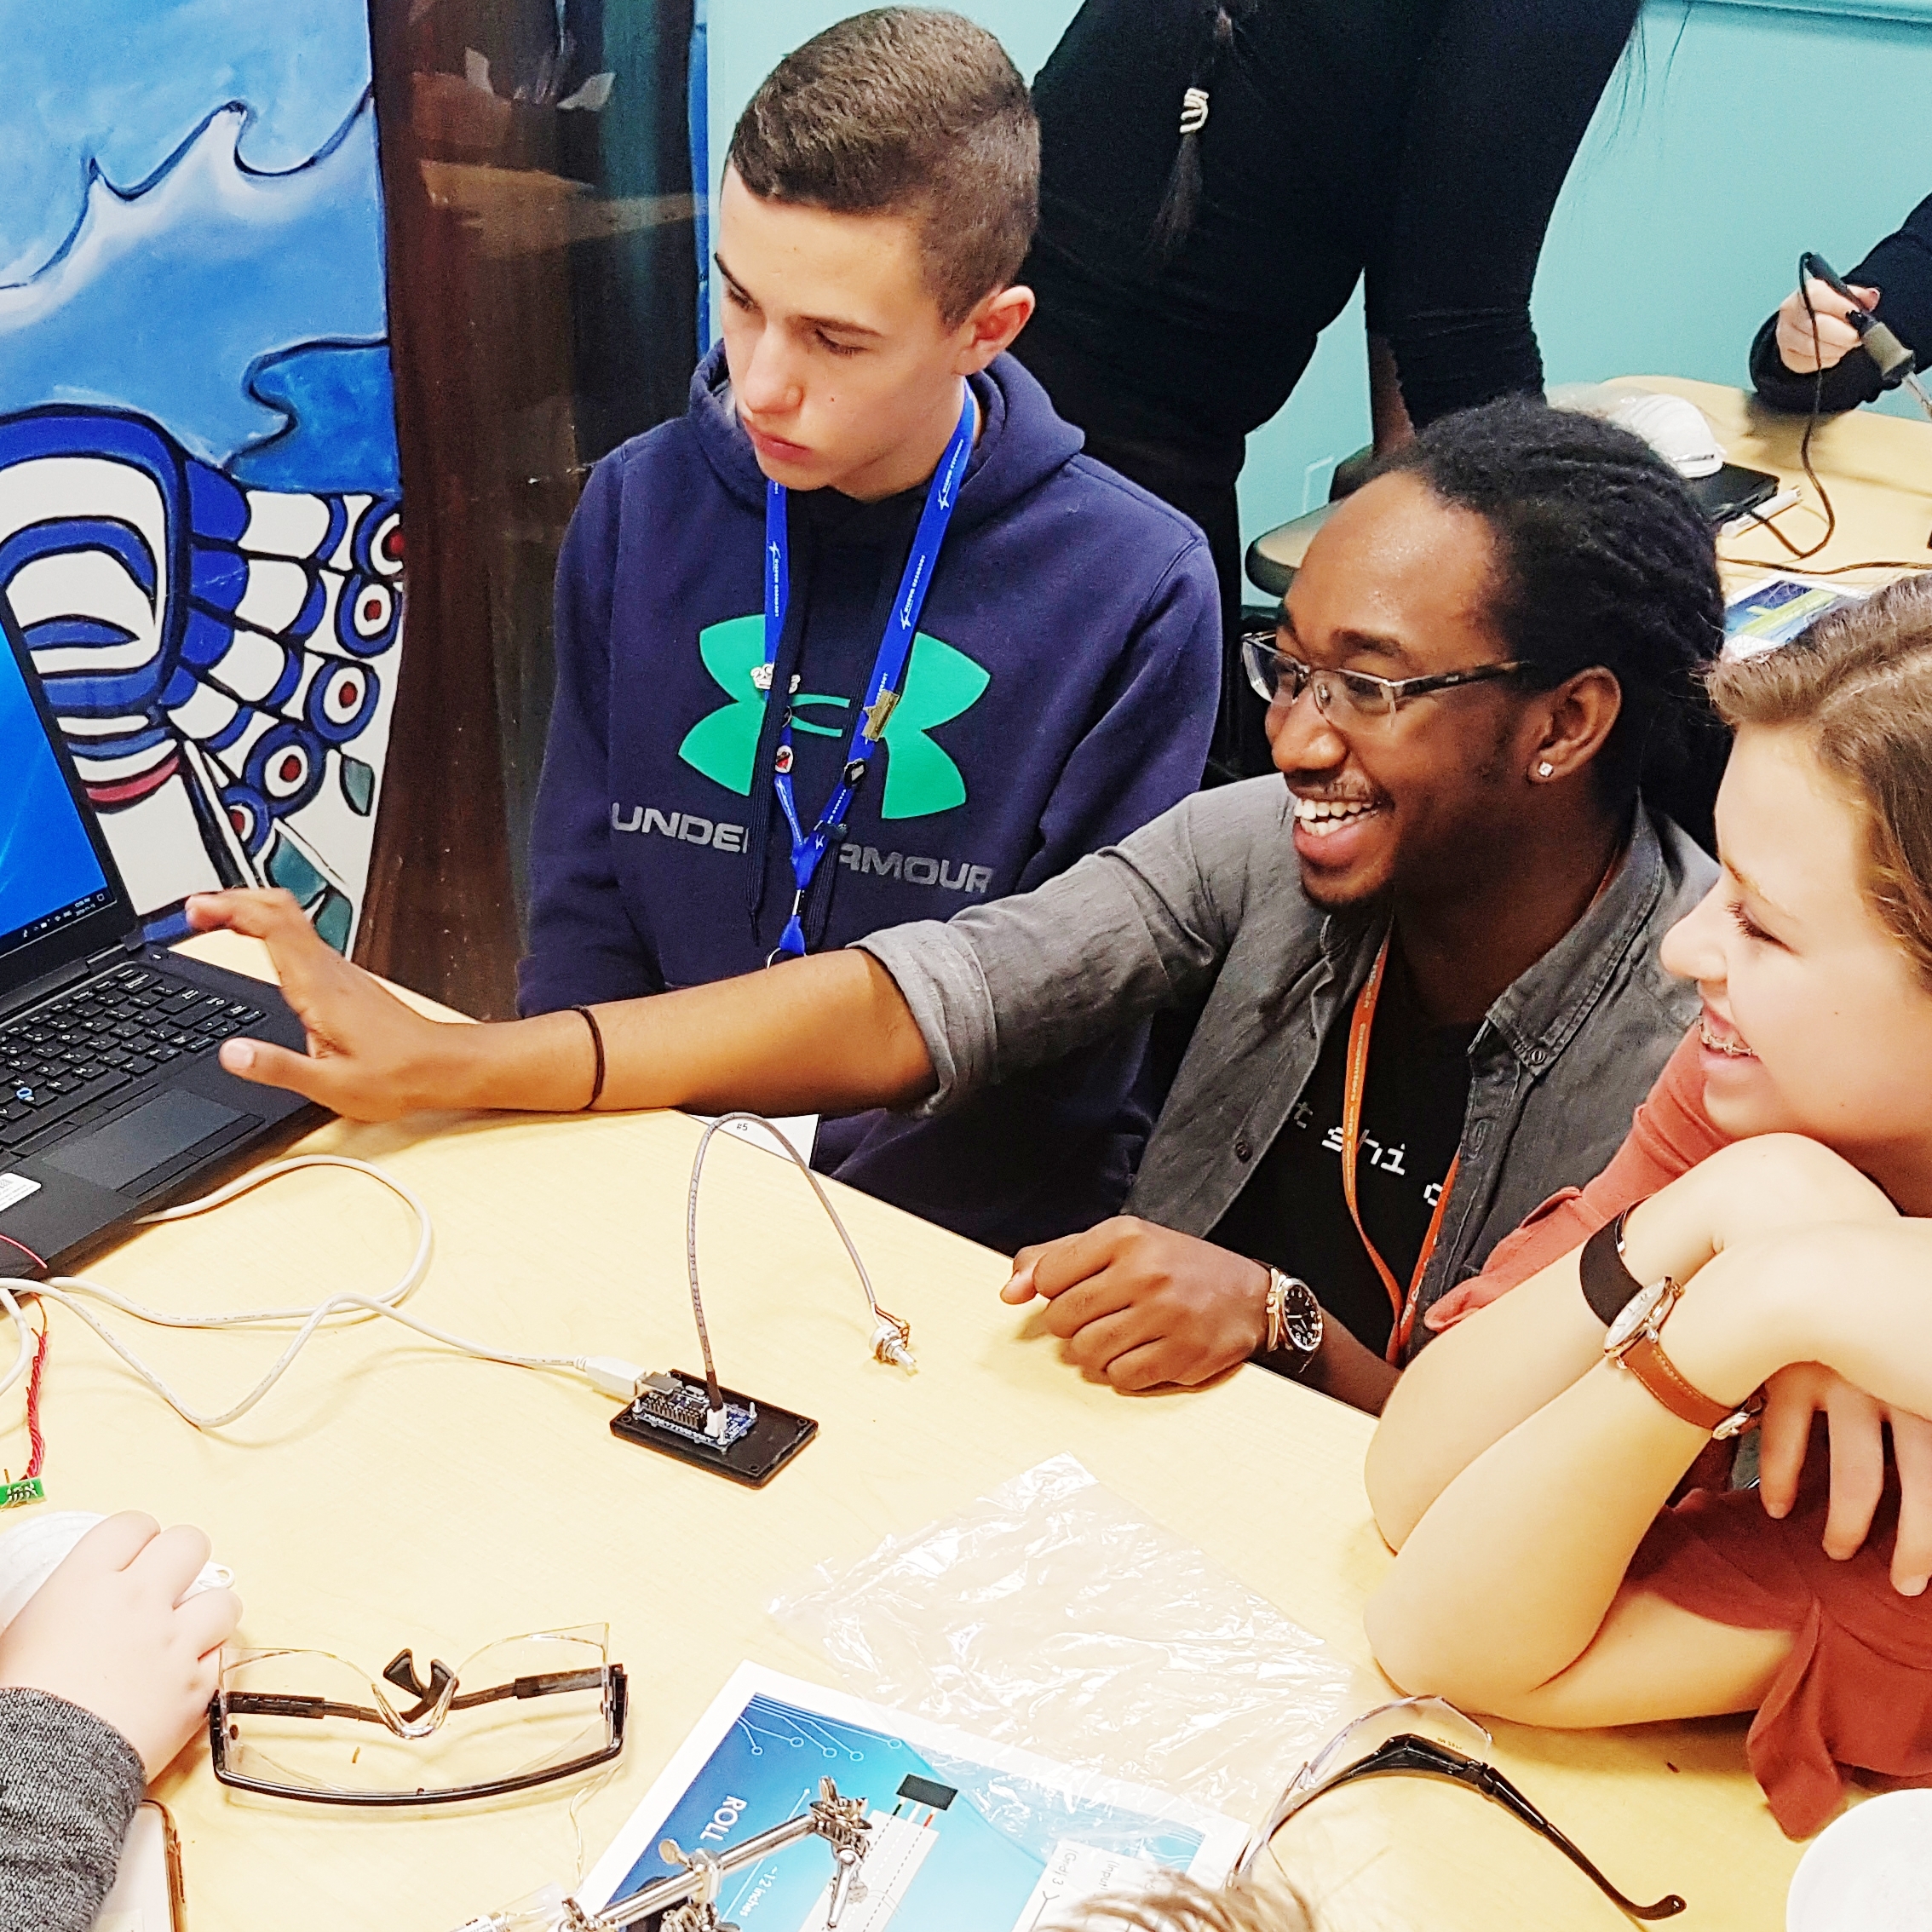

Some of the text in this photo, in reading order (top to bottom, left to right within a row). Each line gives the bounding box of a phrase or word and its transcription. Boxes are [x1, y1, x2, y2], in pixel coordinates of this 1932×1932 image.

[612, 802, 750, 854] UNDE
[839, 843, 993, 894] RMOUR
[699, 1795, 748, 1841] ROLL
[1052, 1877, 1064, 1886] 3
[739, 1887, 767, 1918] inches
